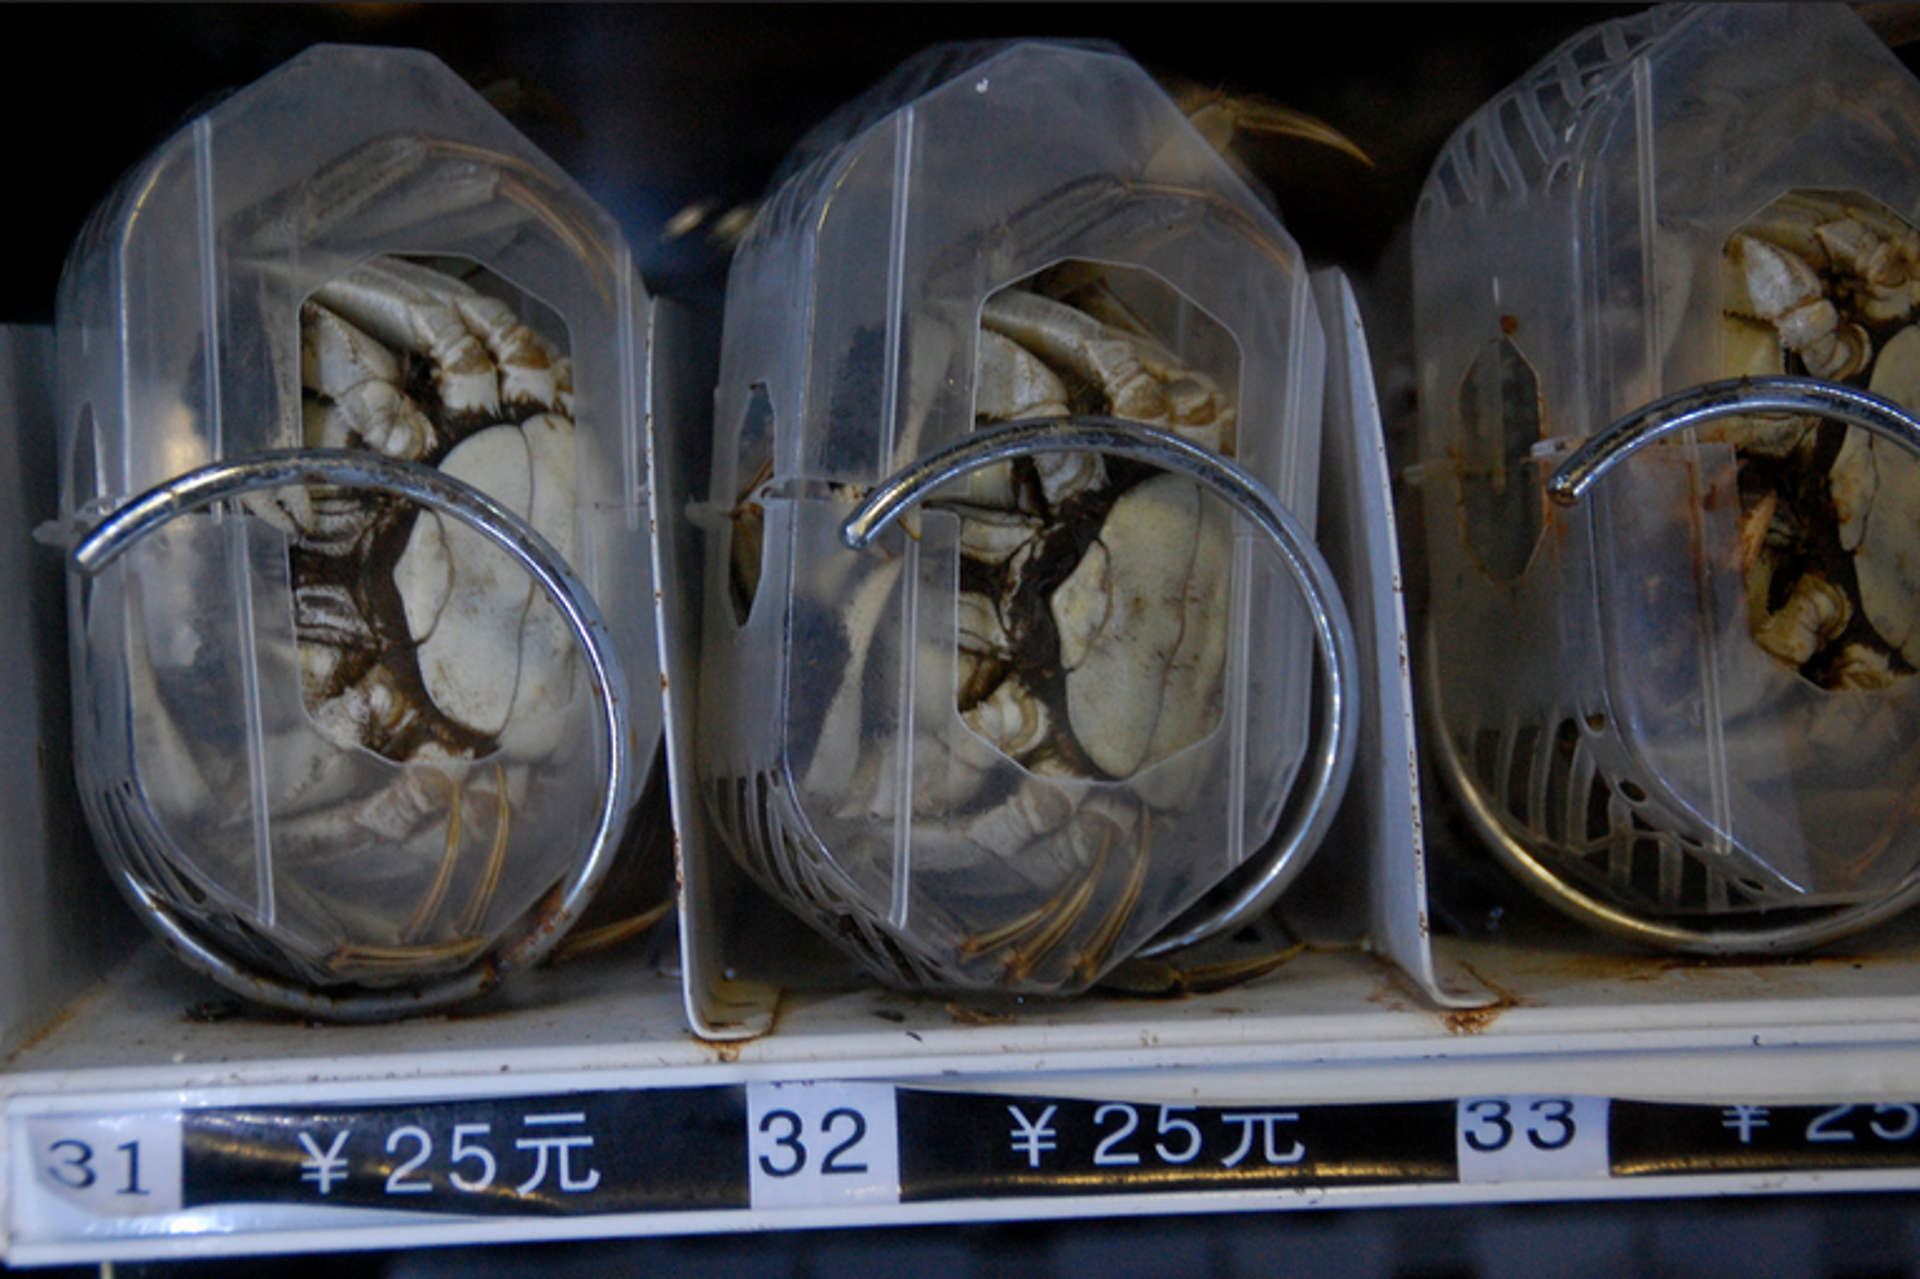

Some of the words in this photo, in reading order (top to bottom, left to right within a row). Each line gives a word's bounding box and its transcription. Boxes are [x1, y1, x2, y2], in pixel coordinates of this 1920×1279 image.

[758, 1107, 868, 1178] 32
[1464, 1100, 1577, 1152] 33
[46, 1139, 150, 1196] 31
